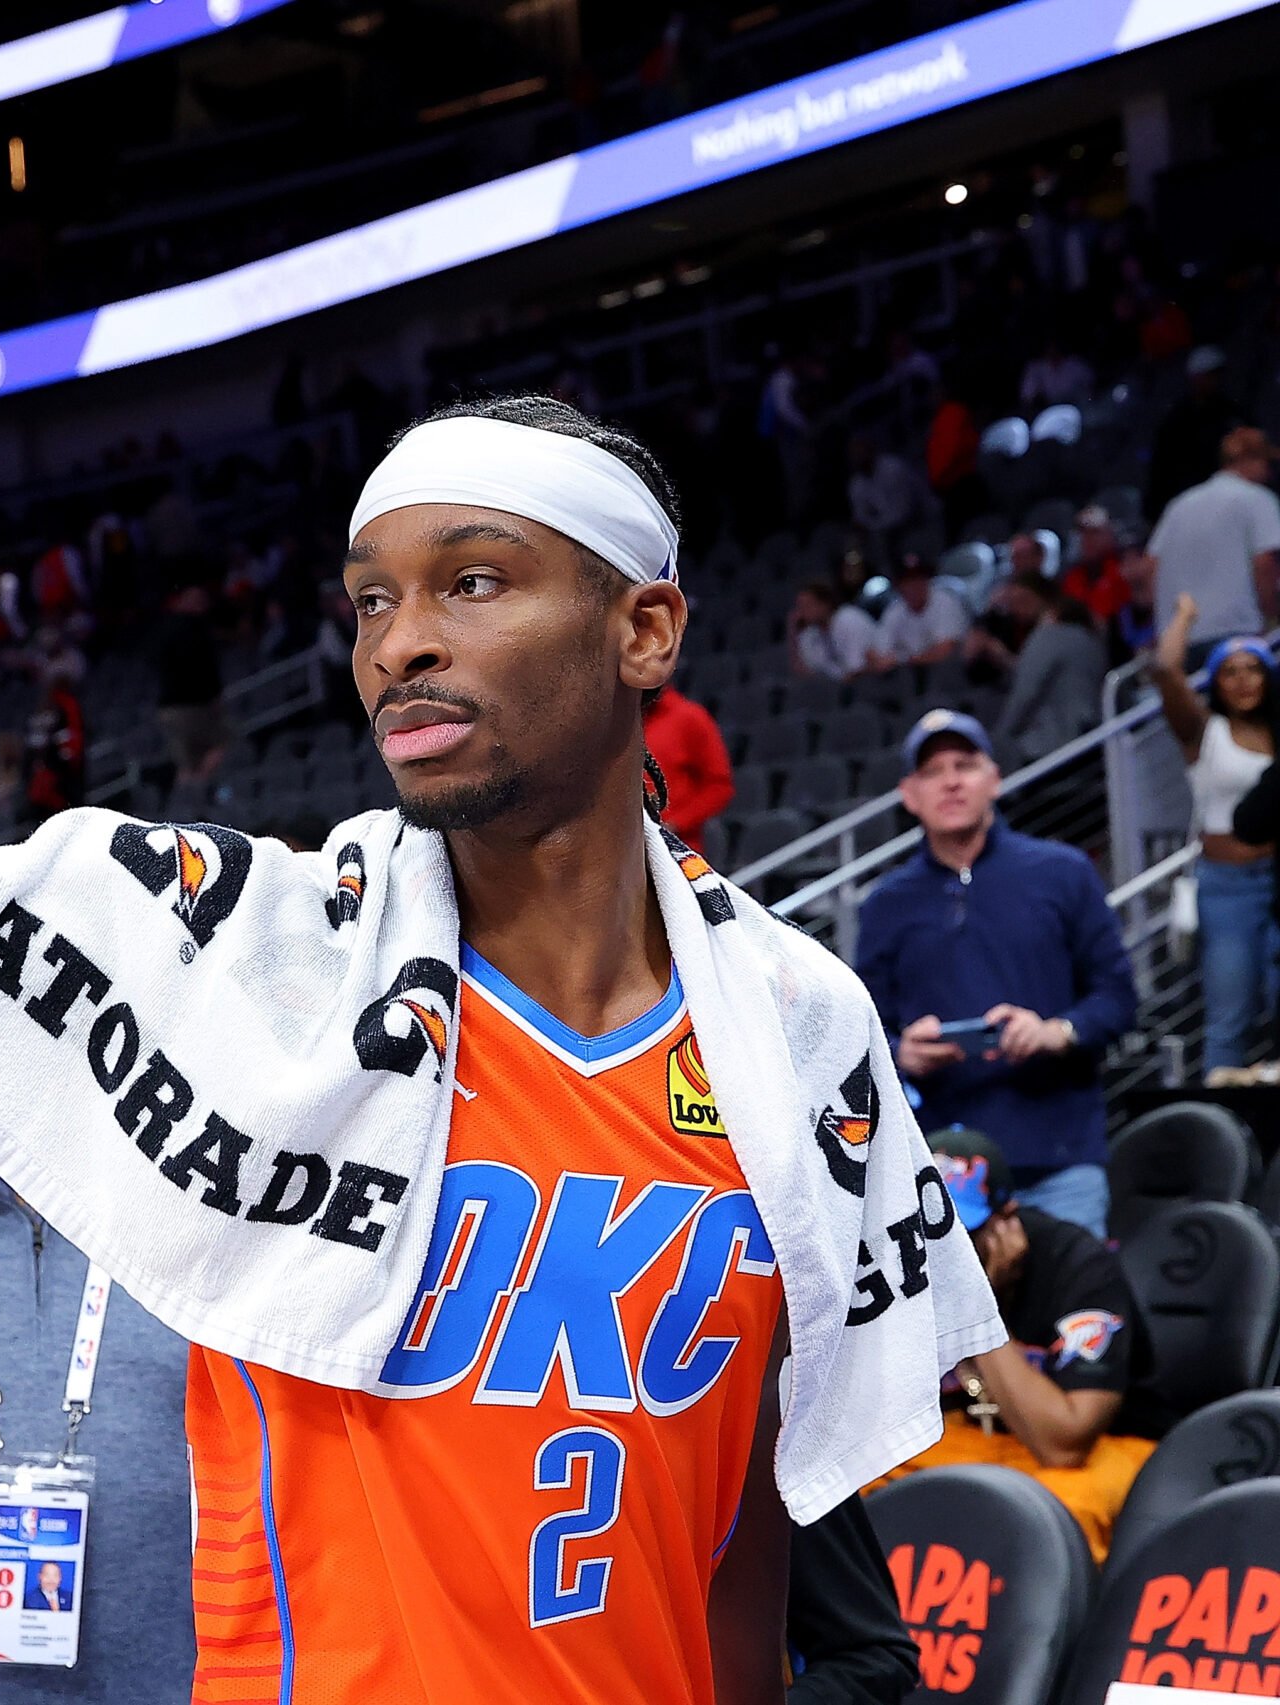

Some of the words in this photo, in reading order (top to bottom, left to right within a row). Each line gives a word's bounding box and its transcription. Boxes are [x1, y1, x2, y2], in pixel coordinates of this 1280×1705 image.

[691, 110, 798, 165] Nothing
[795, 89, 847, 132] but
[847, 42, 967, 112] network
[372, 1159, 778, 1419] OKC
[528, 1425, 627, 1629] 2
[887, 1544, 991, 1630] APA
